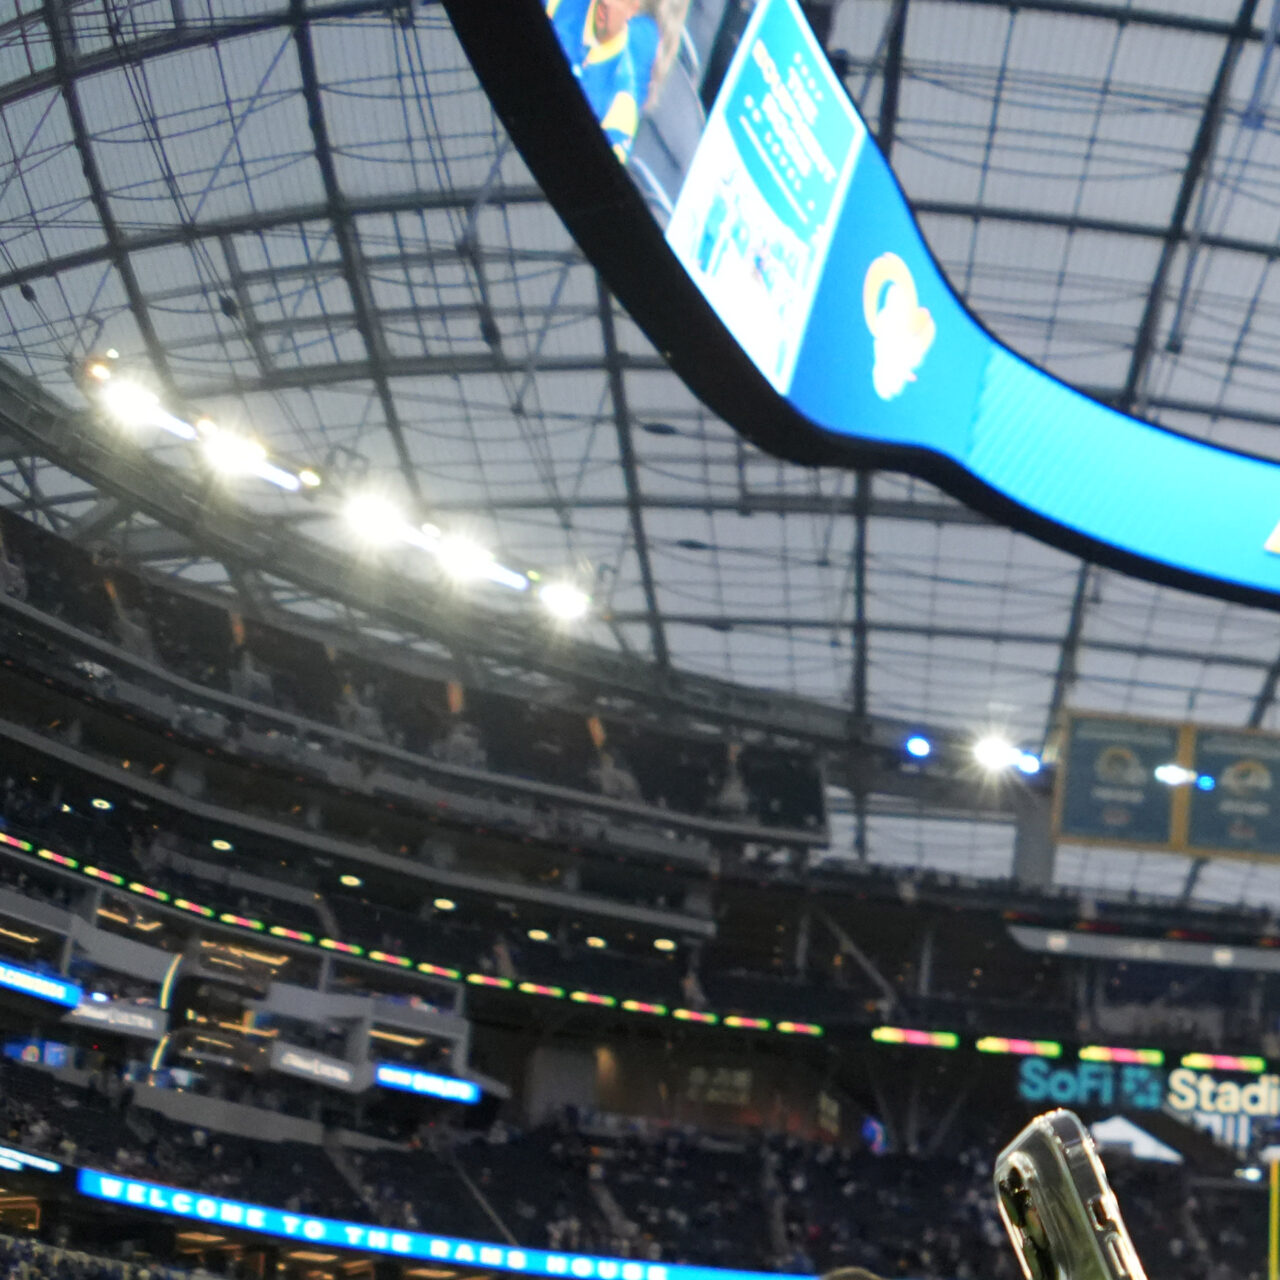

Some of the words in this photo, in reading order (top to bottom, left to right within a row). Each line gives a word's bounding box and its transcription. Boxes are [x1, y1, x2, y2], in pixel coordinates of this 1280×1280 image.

[1018, 1058, 1113, 1107] SoFi
[100, 1177, 266, 1228] WELCOME
[282, 1215, 325, 1240] TO
[345, 1225, 412, 1254] THE
[430, 1238, 527, 1270] RAMS
